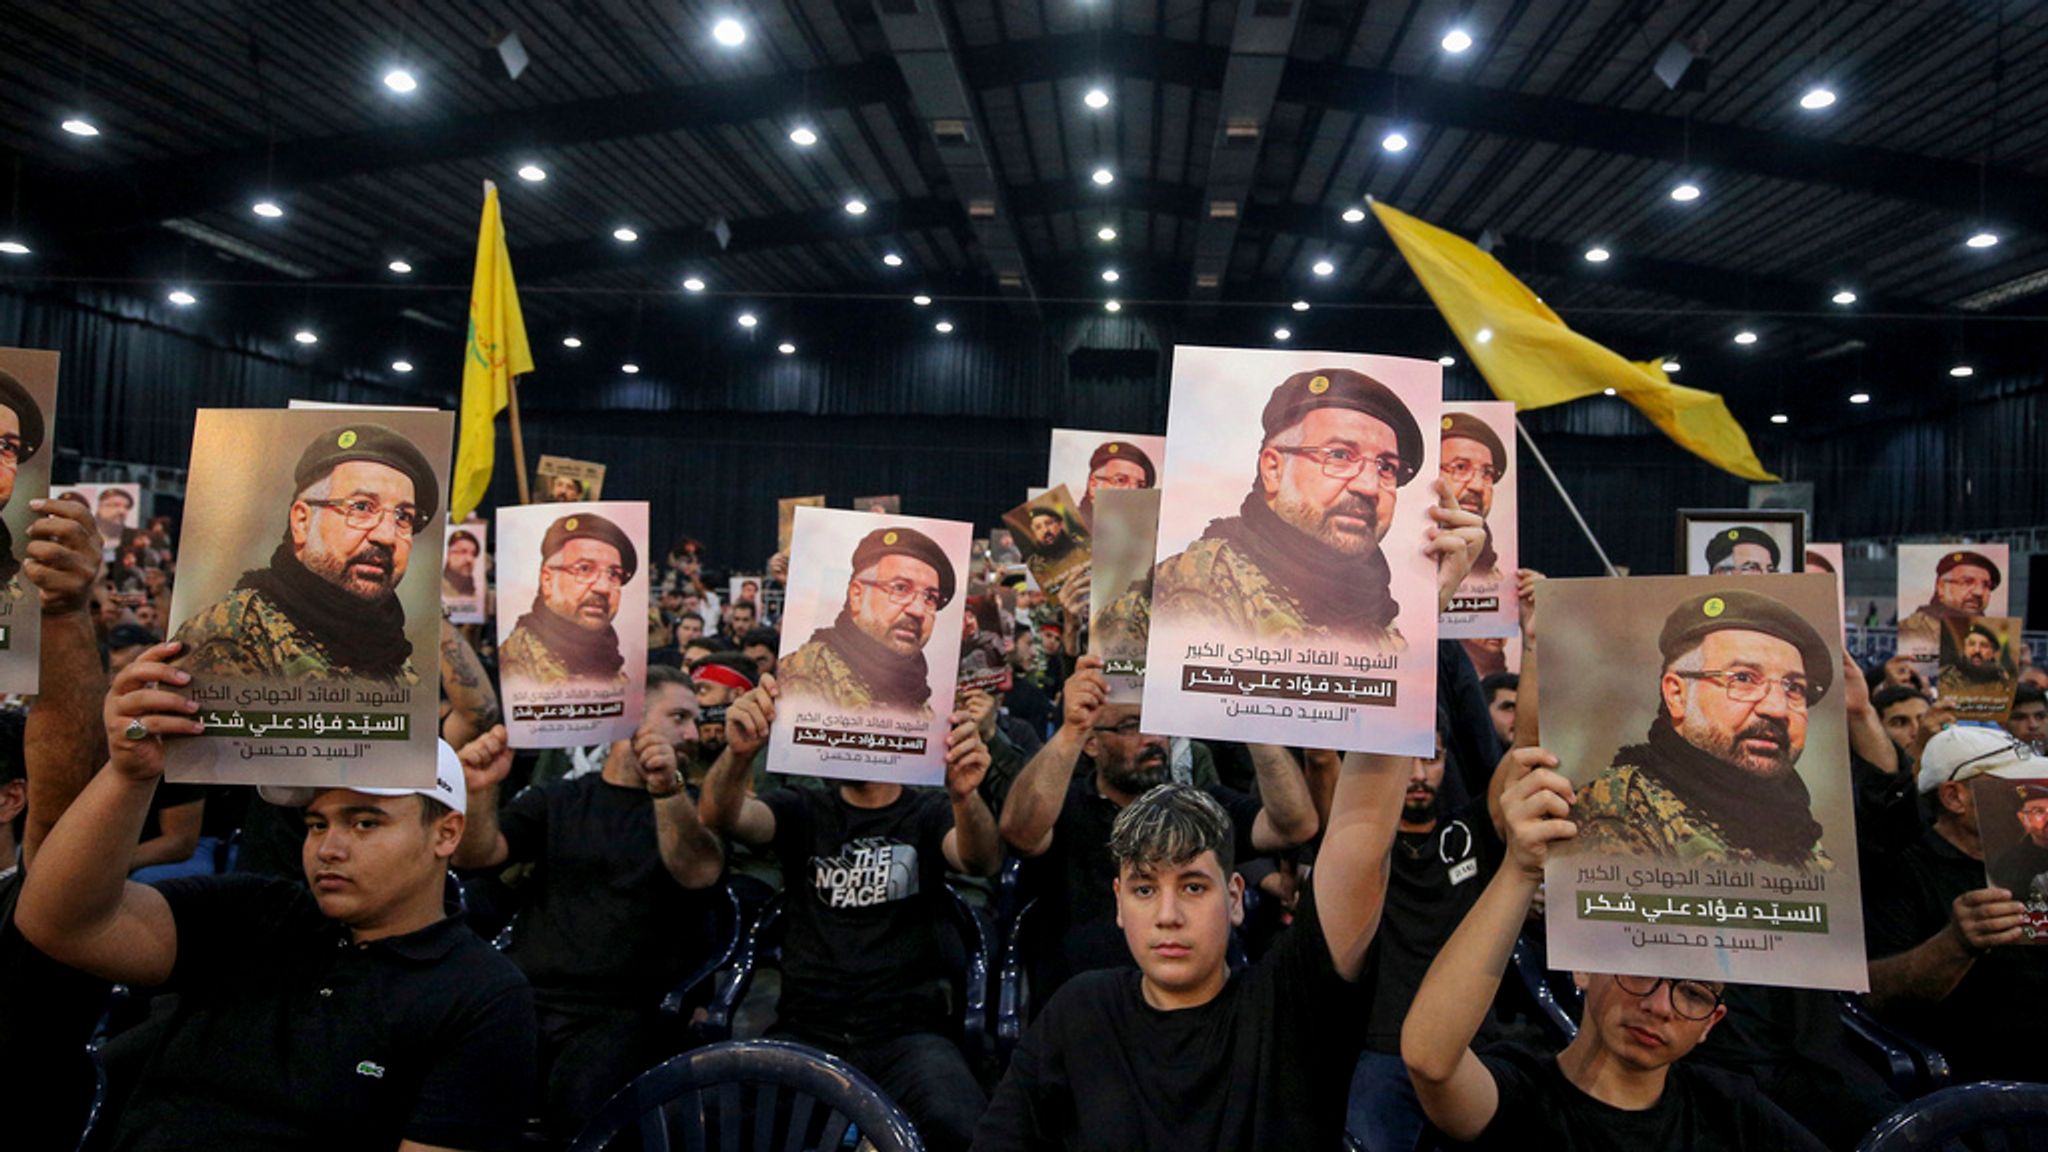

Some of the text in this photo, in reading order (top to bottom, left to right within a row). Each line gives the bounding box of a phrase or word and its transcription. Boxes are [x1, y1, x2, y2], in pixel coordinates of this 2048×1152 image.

[1185, 642, 1398, 672] الشهيد القائد الجهادي الكبير
[1188, 668, 1234, 687] شكر
[1238, 673, 1281, 695] علي
[1286, 674, 1329, 696] فؤاد
[191, 685, 411, 708] الشهيد القائد الجهادي الكبير
[249, 712, 293, 737] علي
[298, 712, 342, 735] فؤاد
[796, 728, 827, 742] شكر
[828, 732, 856, 748] علي
[858, 733, 885, 749] فؤاد
[853, 846, 892, 868] THE
[815, 864, 890, 889] NORTH
[1577, 864, 1825, 895] الشهيد القائد الجهادي الكبير
[831, 884, 888, 909] FACE
[1584, 892, 1636, 915] شكر
[1642, 898, 1691, 924] علي
[1697, 899, 1747, 923] فؤاد
